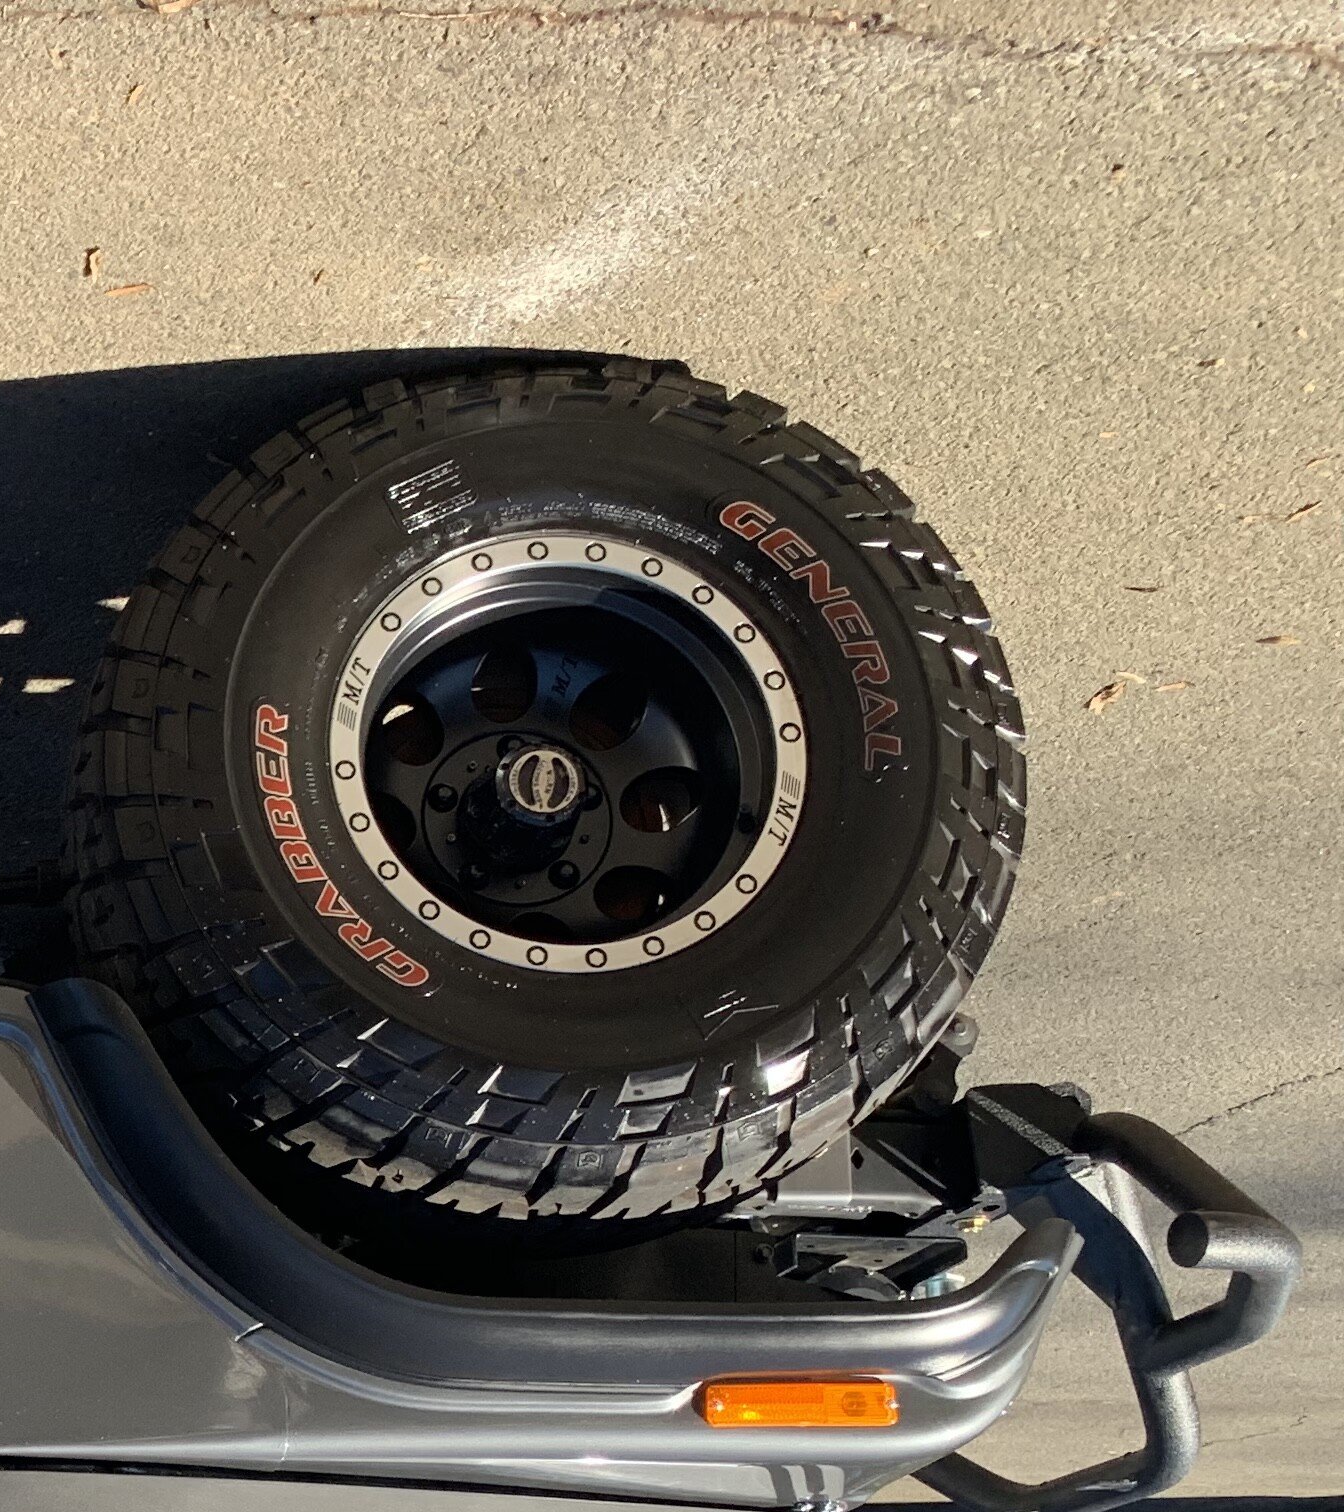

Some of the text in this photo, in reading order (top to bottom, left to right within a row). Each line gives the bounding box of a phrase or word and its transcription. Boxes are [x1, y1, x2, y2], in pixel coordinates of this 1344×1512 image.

[339, 654, 368, 708] M/T
[717, 499, 904, 774] GENERAL
[253, 700, 430, 989] GRABBER
[763, 797, 796, 845] M/T
